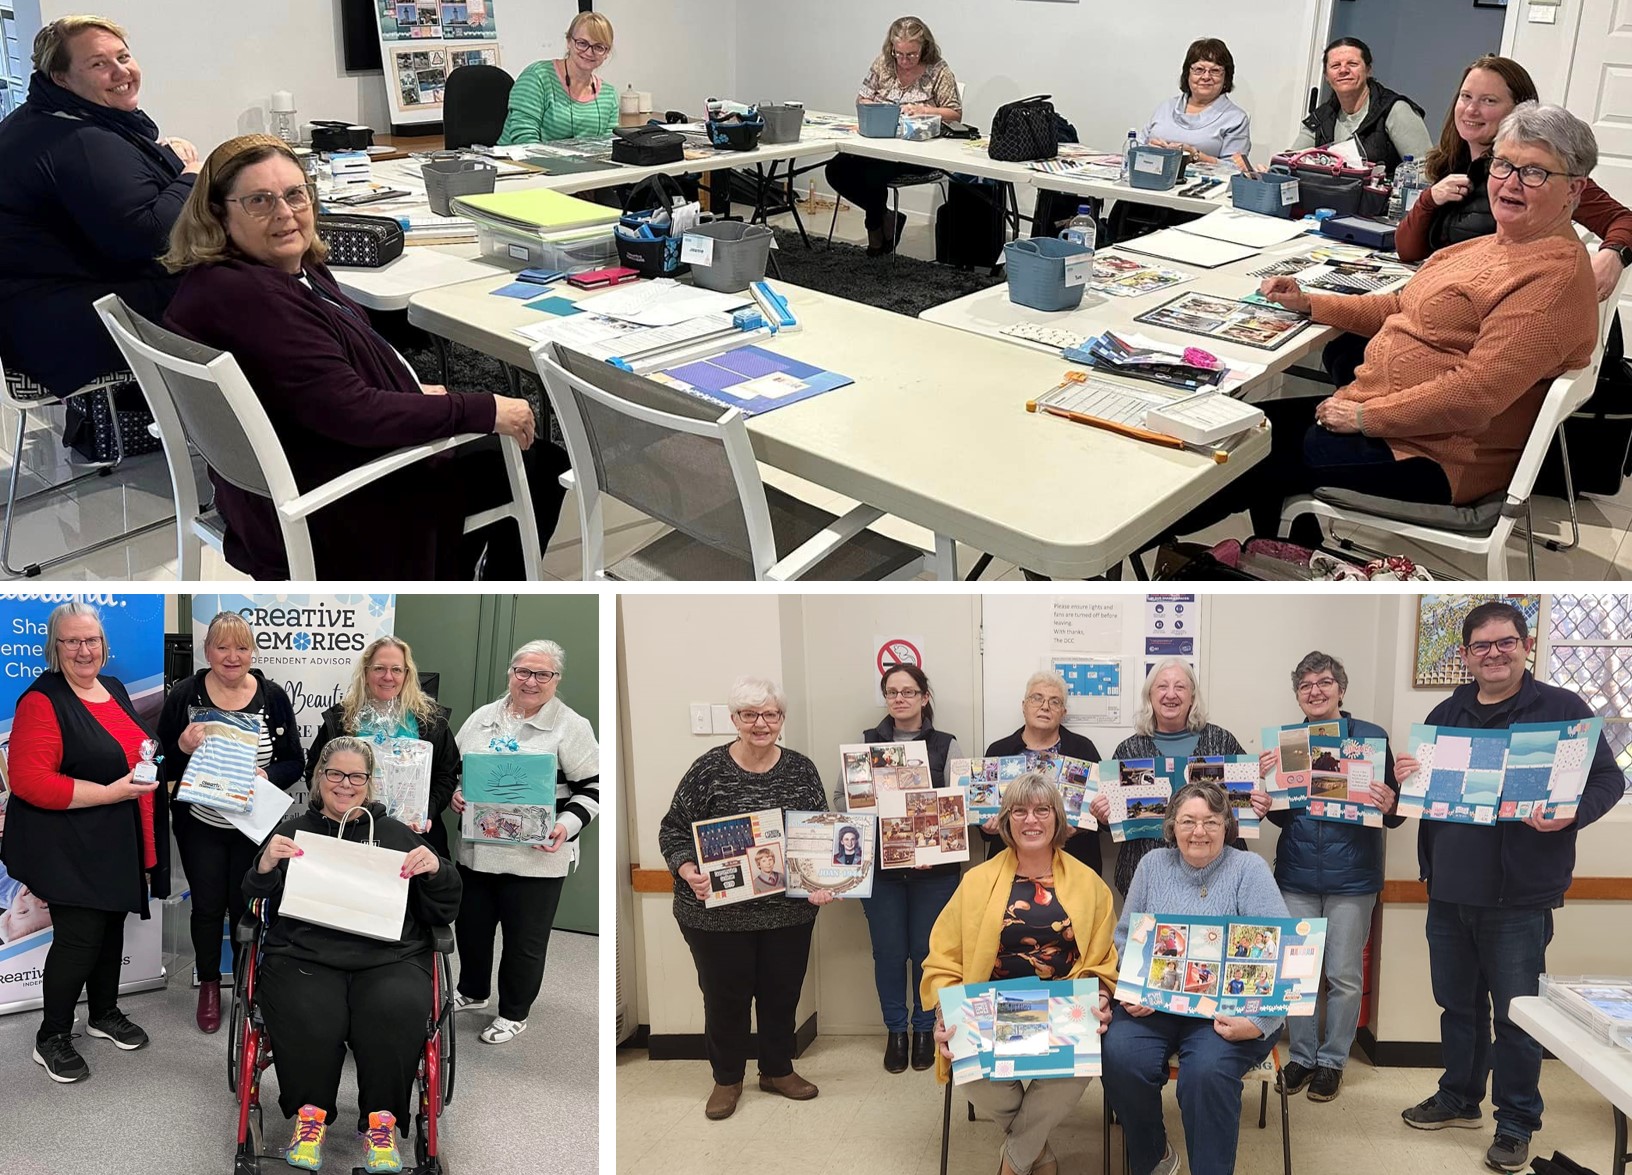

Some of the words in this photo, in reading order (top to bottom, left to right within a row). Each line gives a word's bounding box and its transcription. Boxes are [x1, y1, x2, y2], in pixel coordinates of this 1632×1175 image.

[12, 618, 48, 635] Sha
[1, 643, 43, 656] eme
[252, 657, 307, 665] DEPENDENT
[310, 657, 351, 665] ADVISOR
[285, 681, 343, 715] Beauti
